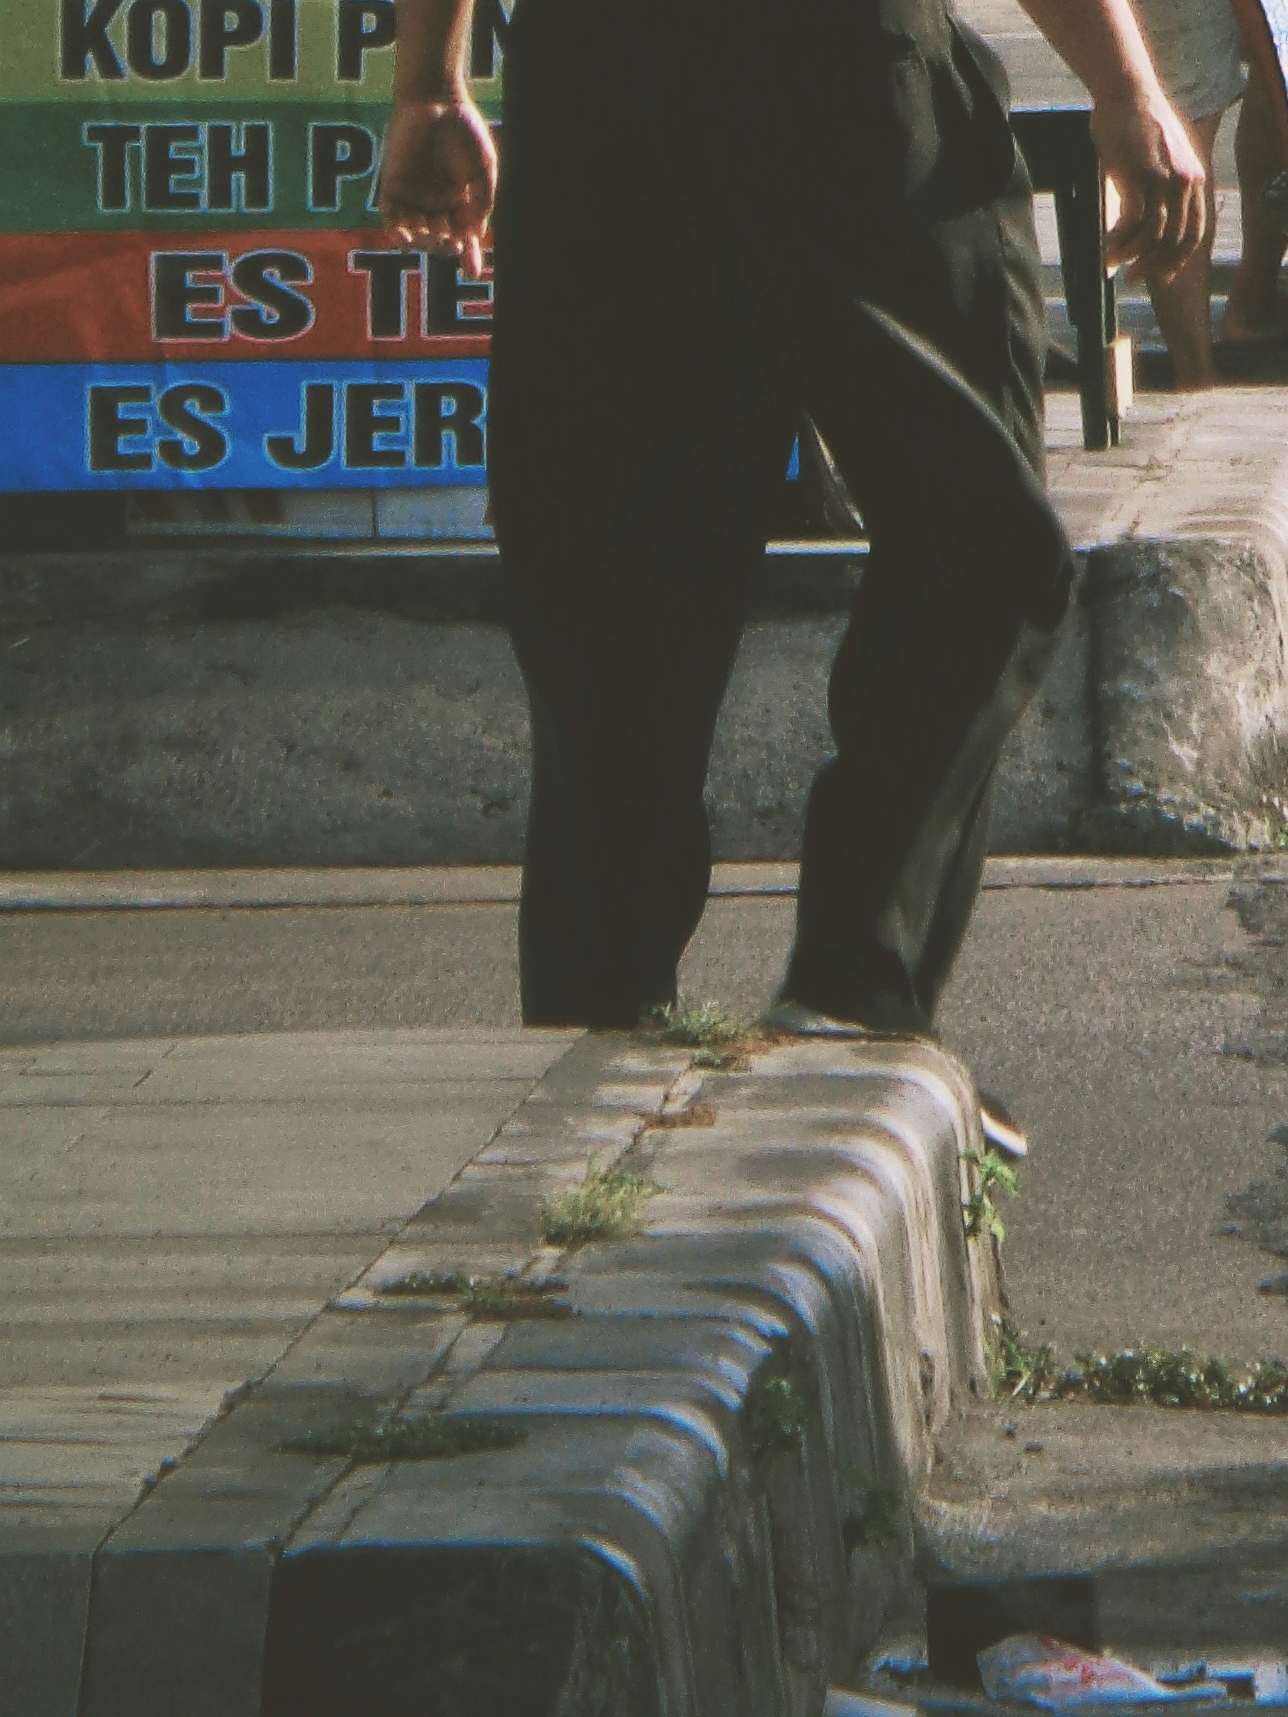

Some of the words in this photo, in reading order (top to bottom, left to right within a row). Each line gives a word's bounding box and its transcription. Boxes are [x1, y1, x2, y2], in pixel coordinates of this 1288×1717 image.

[83, 121, 274, 213] TEH
[306, 121, 386, 213] P
[150, 248, 316, 342] ES
[85, 380, 231, 473] ES
